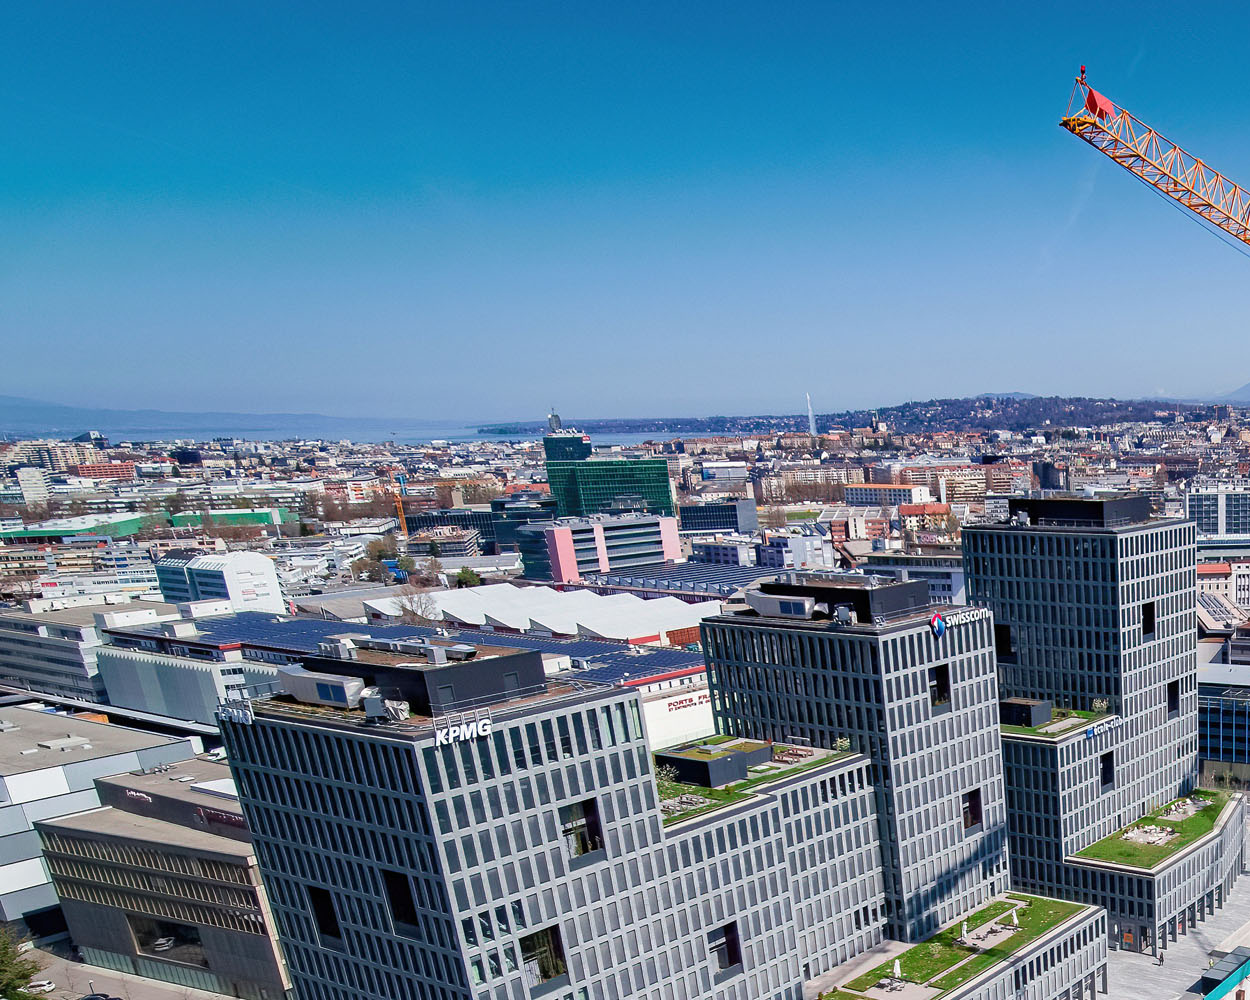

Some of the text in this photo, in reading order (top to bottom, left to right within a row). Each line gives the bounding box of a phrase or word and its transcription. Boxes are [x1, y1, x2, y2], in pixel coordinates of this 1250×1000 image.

[946, 608, 988, 627] swisscom
[667, 698, 694, 708] PORTS
[436, 719, 491, 746] KPMG
